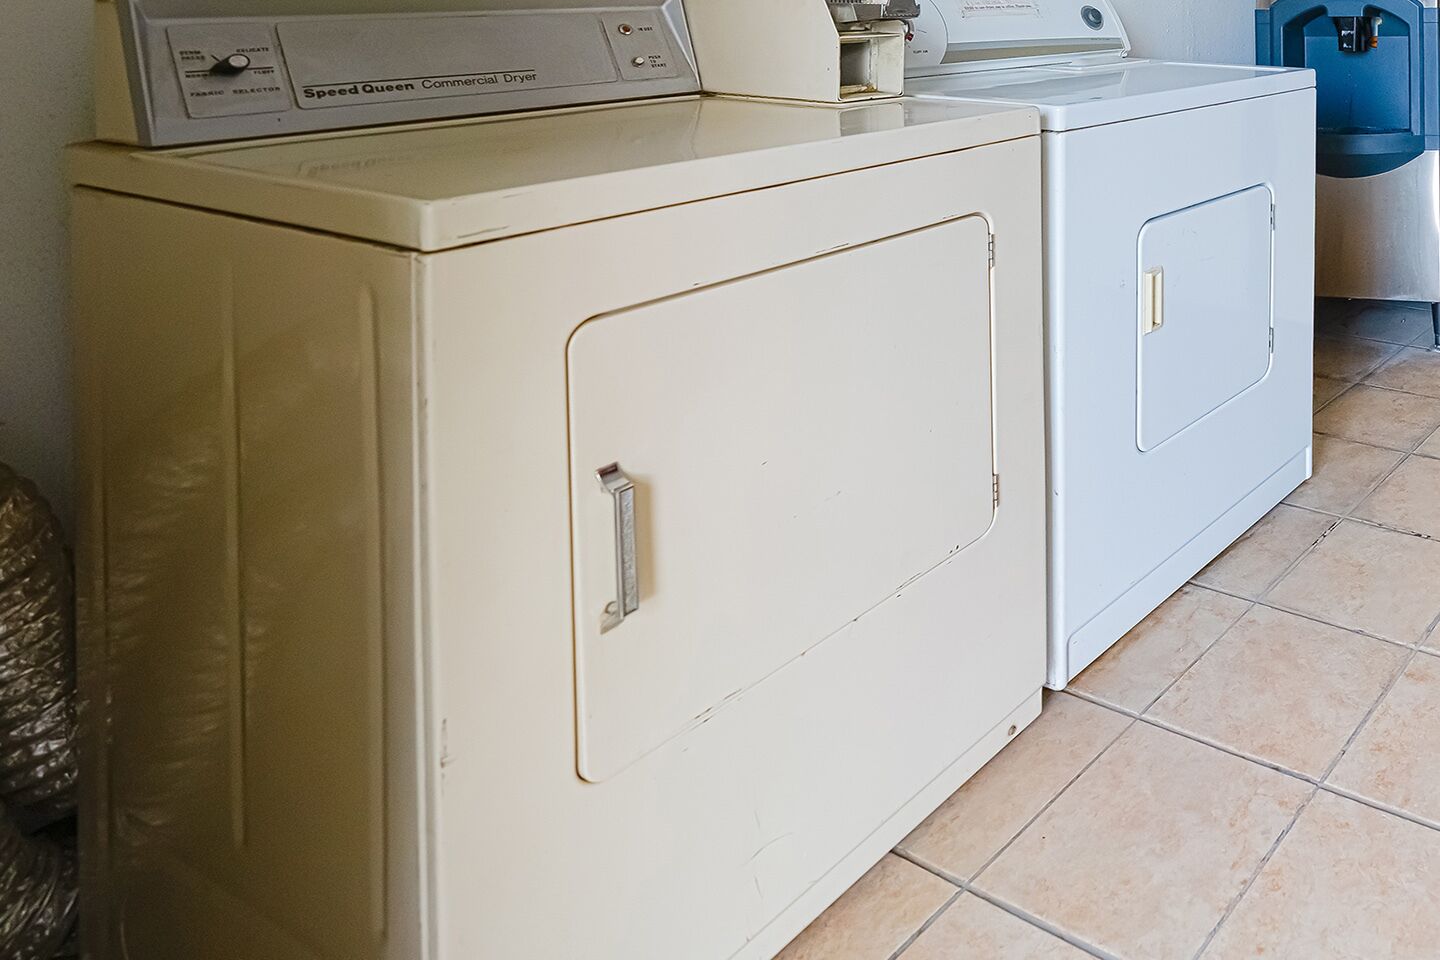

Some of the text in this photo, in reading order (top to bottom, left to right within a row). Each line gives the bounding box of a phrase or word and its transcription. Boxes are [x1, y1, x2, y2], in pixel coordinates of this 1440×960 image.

[232, 87, 281, 95] SELECTOR
[303, 72, 537, 100] Speed Queen Commercial Dryer
